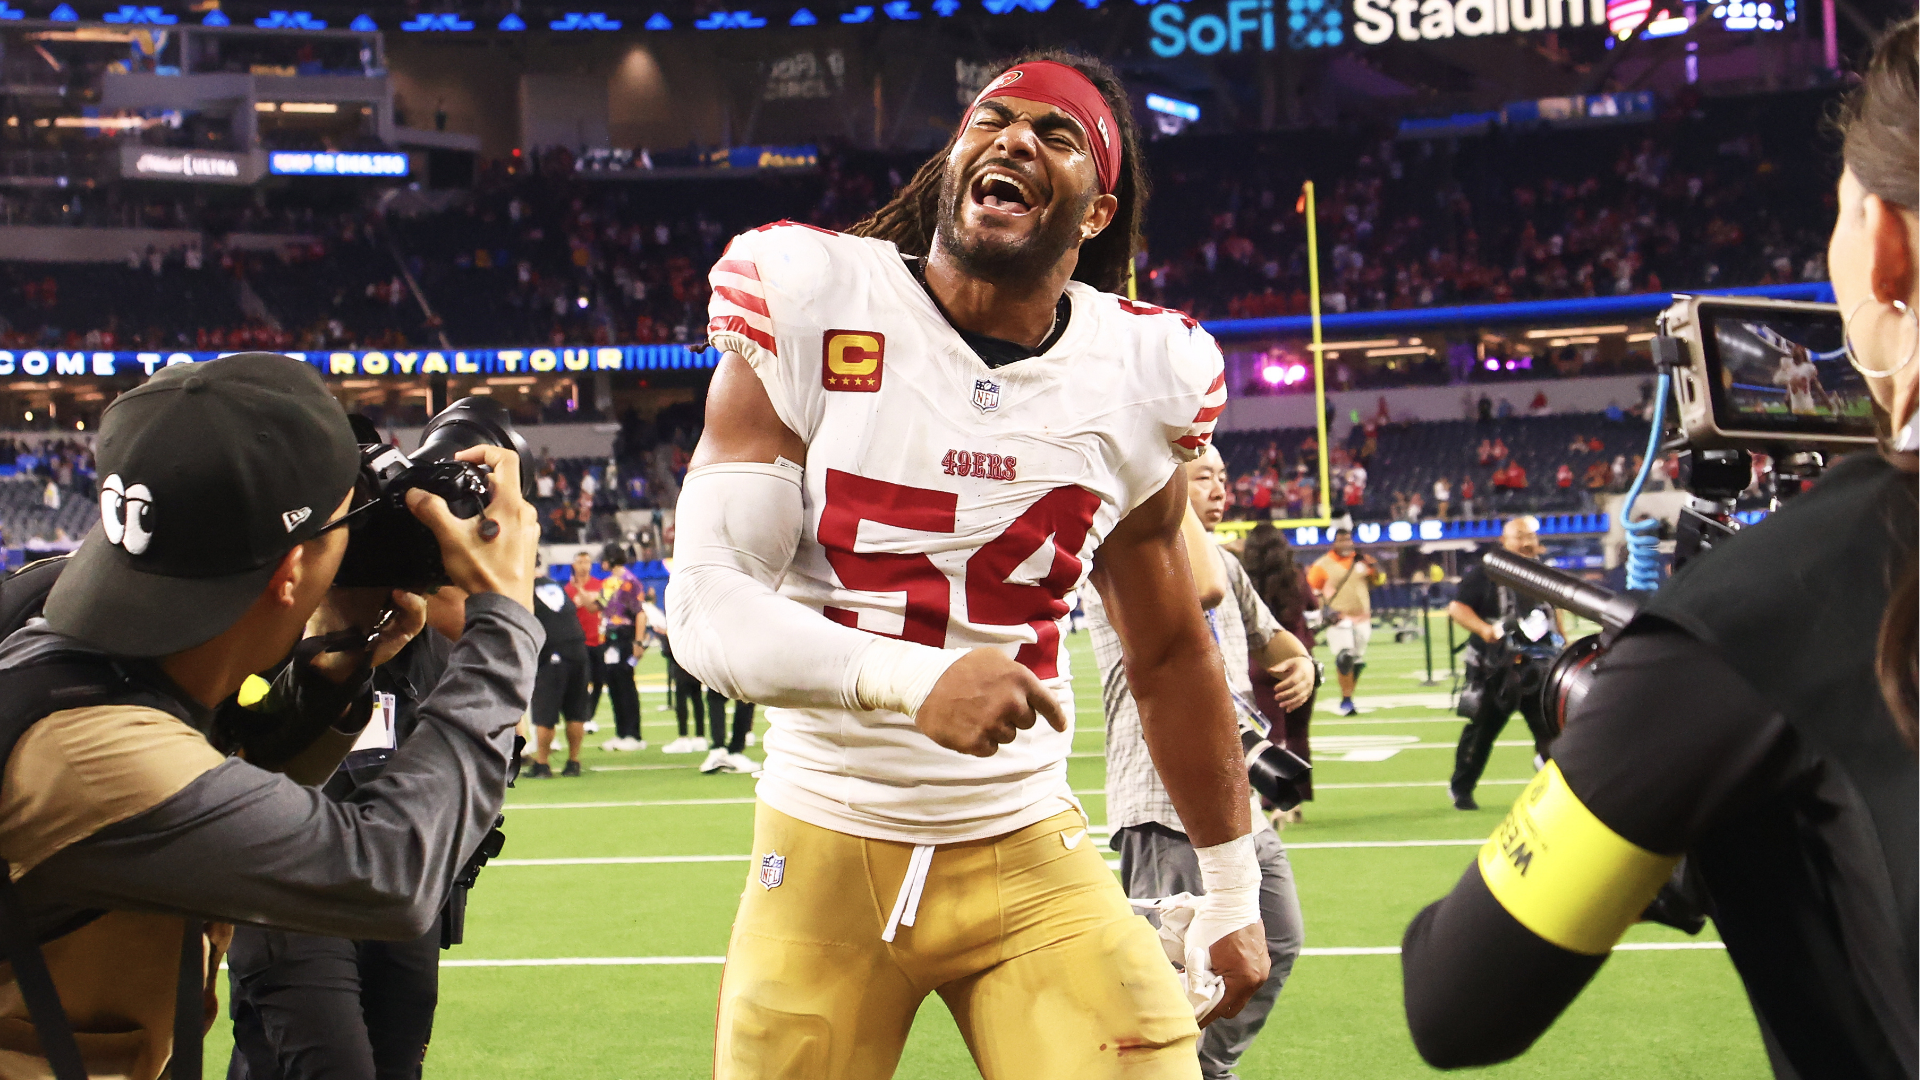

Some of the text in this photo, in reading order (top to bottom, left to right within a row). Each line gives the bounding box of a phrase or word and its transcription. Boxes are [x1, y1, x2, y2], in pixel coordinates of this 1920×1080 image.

[1150, 0, 1275, 57] SoFi
[1353, 0, 1604, 45] Stadium
[329, 347, 623, 375] ROYAL TOUR
[828, 334, 880, 376] C
[976, 390, 996, 406] NFL
[941, 448, 1017, 481] 49ERS
[817, 468, 1101, 680] 54
[762, 867, 778, 883] NFL
